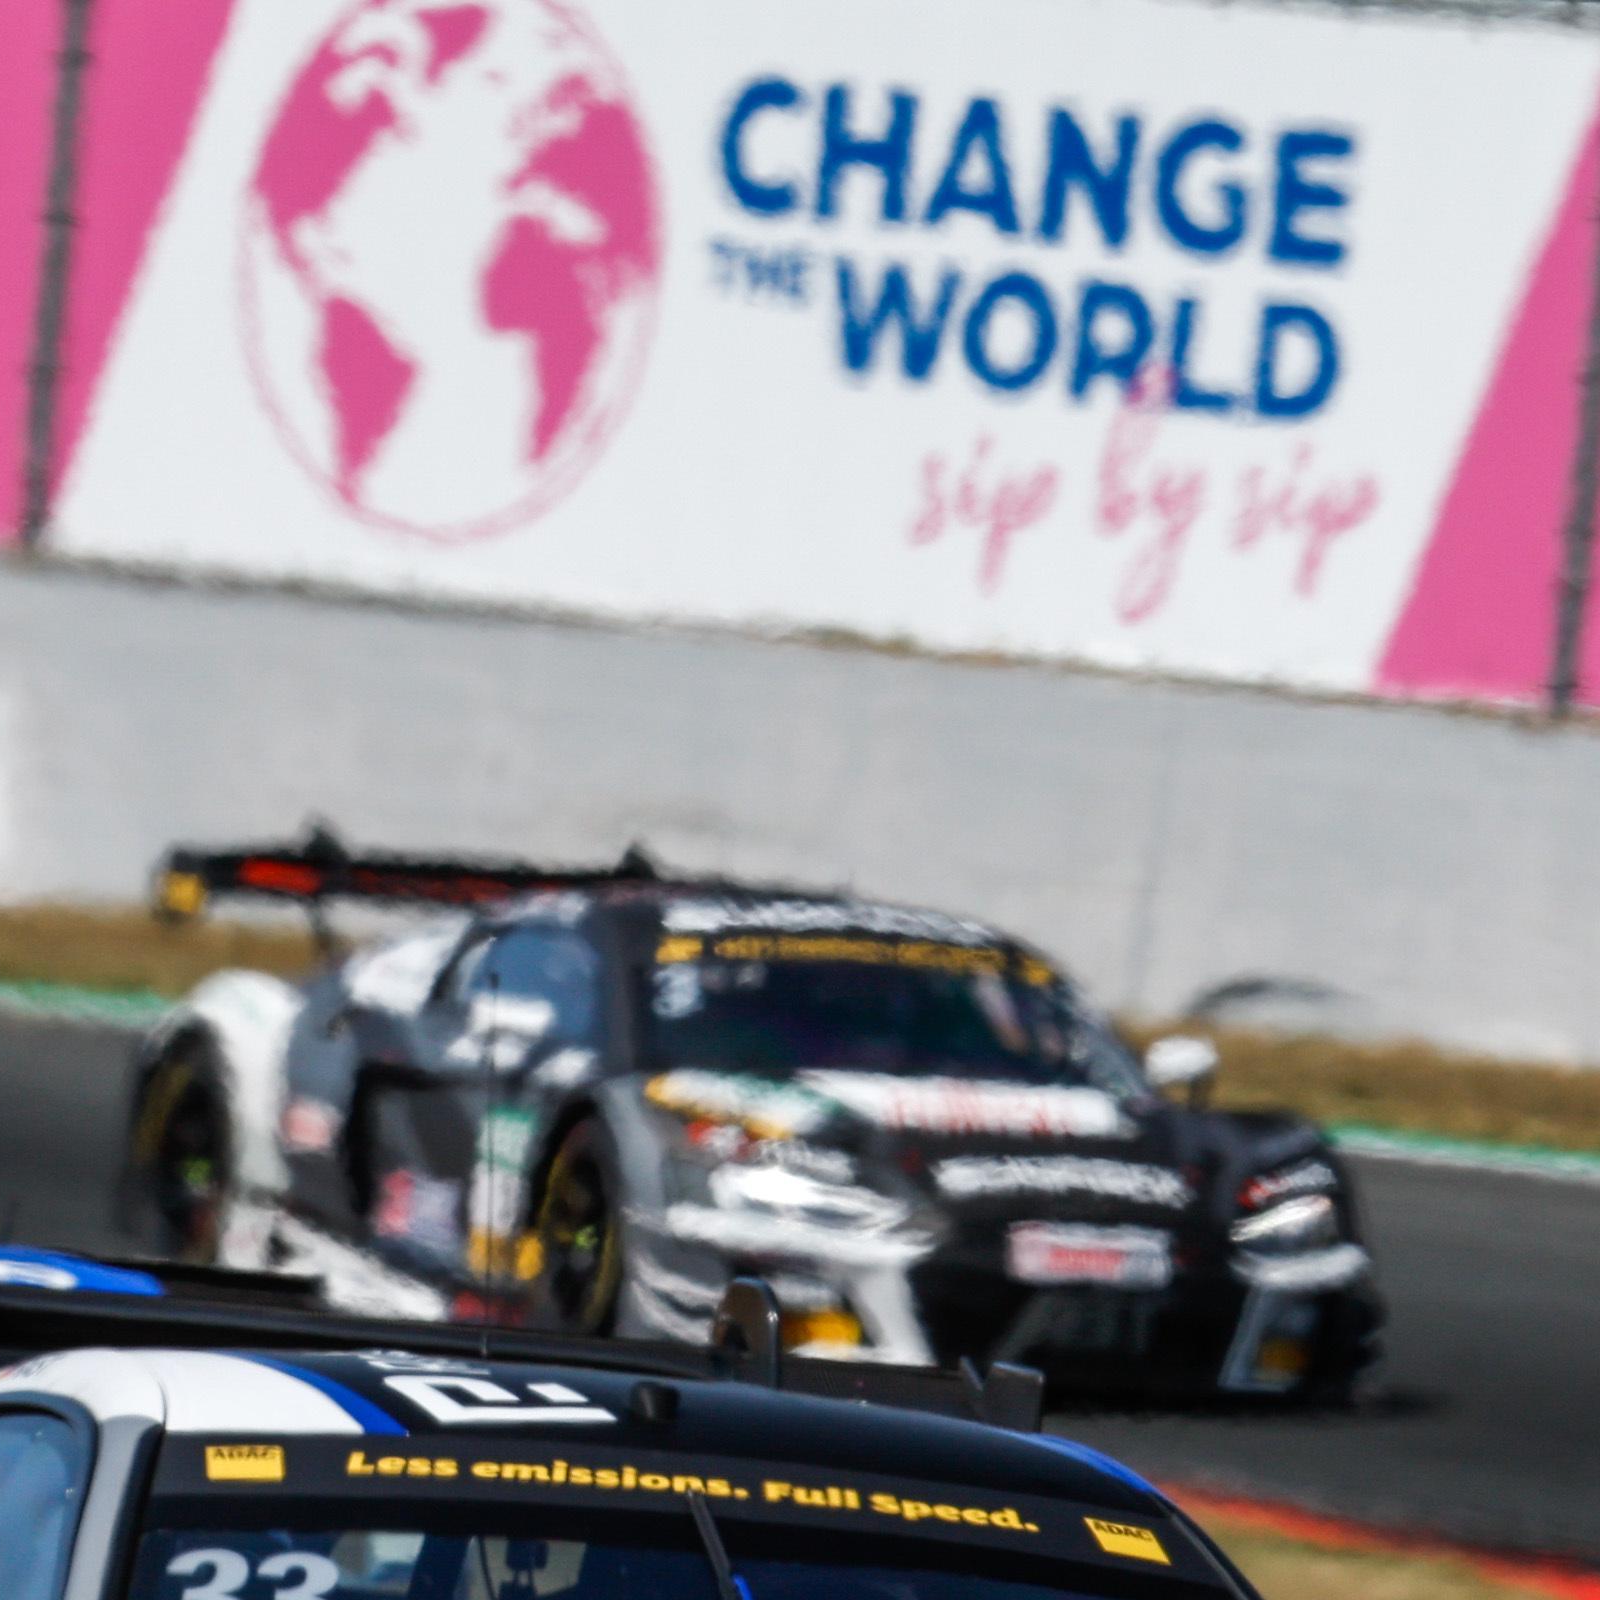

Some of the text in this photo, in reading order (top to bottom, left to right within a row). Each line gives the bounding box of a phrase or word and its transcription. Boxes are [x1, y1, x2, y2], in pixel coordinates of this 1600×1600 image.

[718, 72, 1358, 270] CHANGE
[708, 236, 1344, 426] THE WORLD
[908, 364, 1382, 628] sip by sip
[346, 1450, 460, 1478] Less
[470, 1459, 750, 1500] emissions.
[762, 1480, 861, 1512] Full
[868, 1491, 1042, 1534] Speed.
[1092, 1516, 1154, 1543] ADAC
